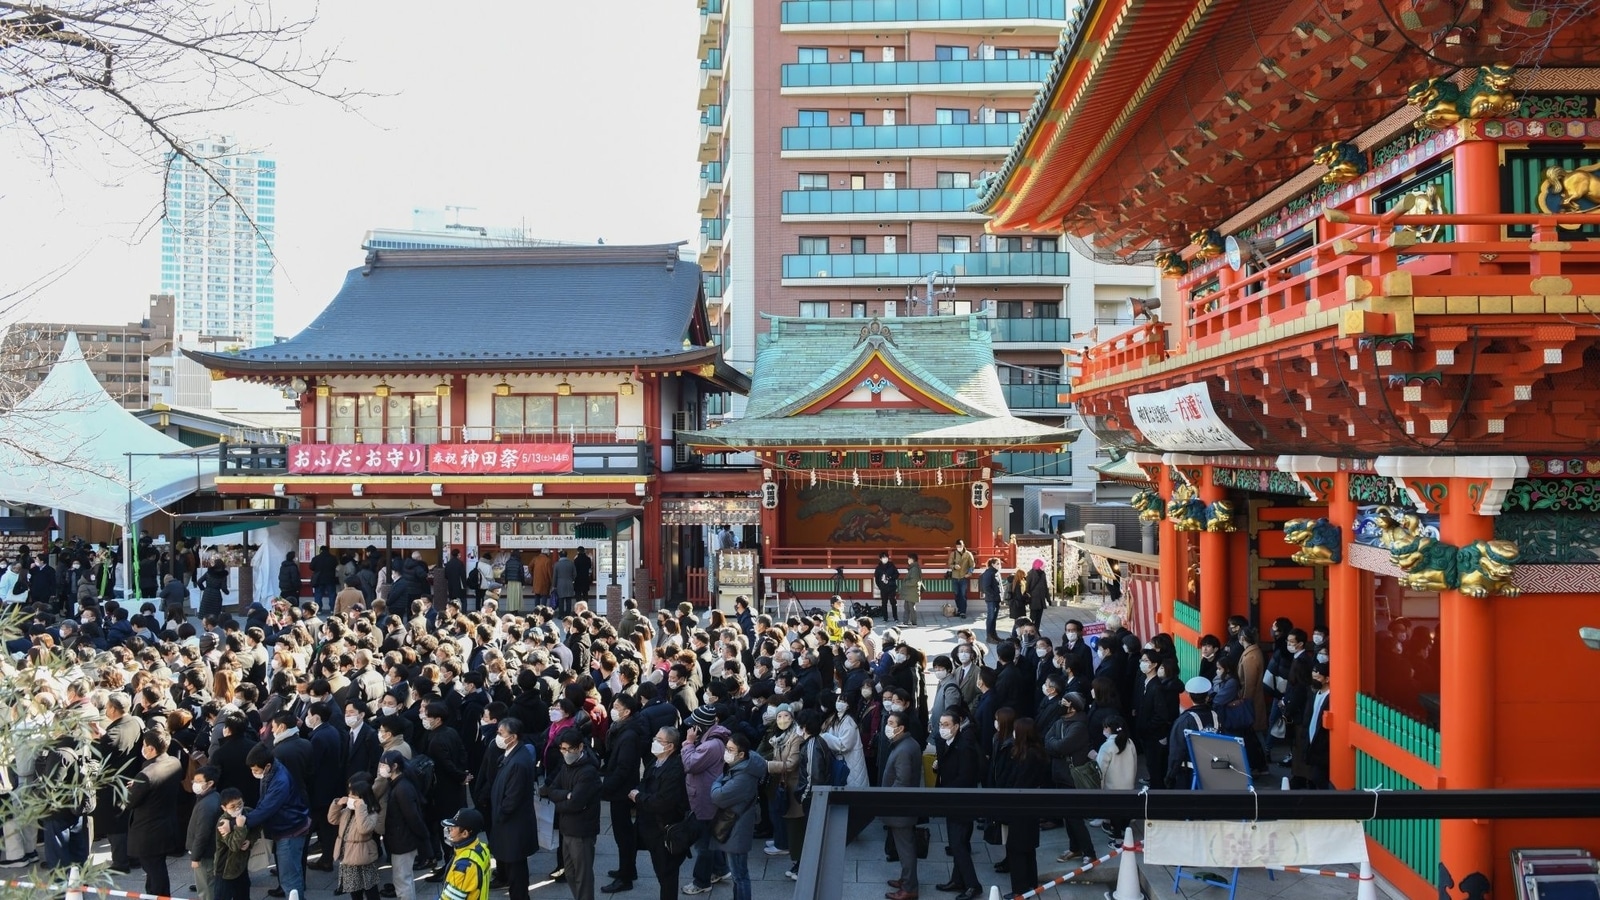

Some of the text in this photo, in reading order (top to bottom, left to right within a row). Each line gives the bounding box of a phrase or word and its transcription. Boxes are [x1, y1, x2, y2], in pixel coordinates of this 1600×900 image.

[294, 449, 421, 467] おふだ・お守り
[432, 452, 458, 465] 奉祝
[460, 448, 519, 468] 神田祭
